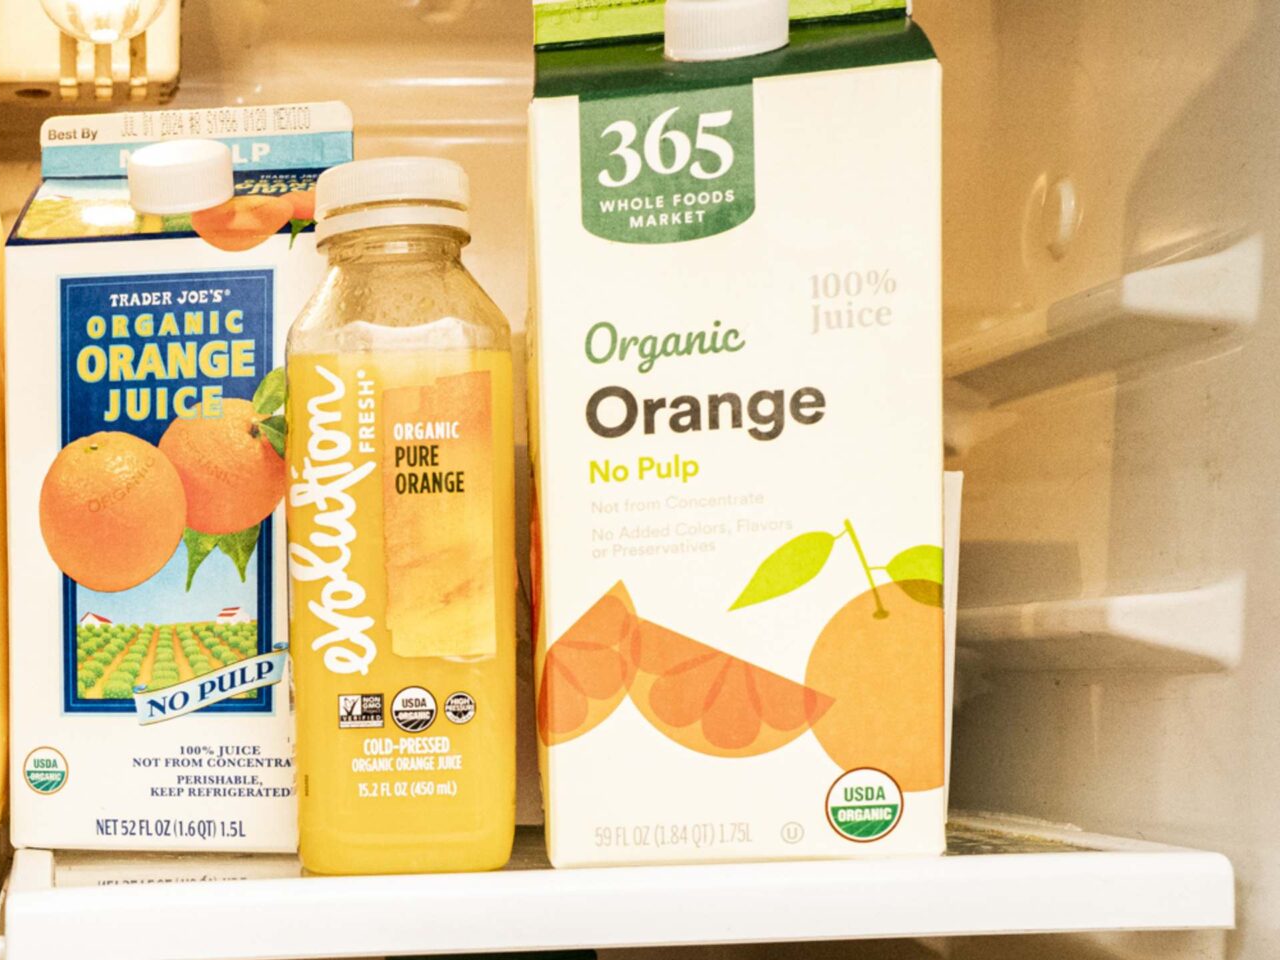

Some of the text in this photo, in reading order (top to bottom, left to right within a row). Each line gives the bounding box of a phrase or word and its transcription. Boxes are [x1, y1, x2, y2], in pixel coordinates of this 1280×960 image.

[47, 128, 98, 142] Best By
[598, 107, 734, 187] 365
[599, 190, 735, 213] WHOLE FOODS
[629, 210, 705, 229] MARKET
[809, 269, 896, 299] 100%
[110, 292, 173, 307] TRADER
[86, 310, 244, 339] ORGANIC
[811, 302, 892, 334] Juice
[584, 320, 746, 374] Organic
[76, 339, 256, 383] ORANGE
[104, 386, 223, 422] JUICE
[585, 385, 826, 441] Orange
[359, 380, 375, 453] FRESH
[393, 421, 460, 440] ORGANIC
[395, 445, 439, 468] PURE
[589, 454, 699, 484] No Pulp
[395, 471, 465, 495] ORANGE
[148, 660, 275, 717] NO PULP
[363, 737, 450, 755] COLD-PRESSED
[352, 755, 462, 773] ORGANIC ORANGE JUICE
[177, 775, 263, 786] PERISHABLE,
[150, 787, 291, 798] KEEP REFRIGERATED
[844, 786, 886, 802] USDA
[837, 807, 892, 822] ORGANIC
